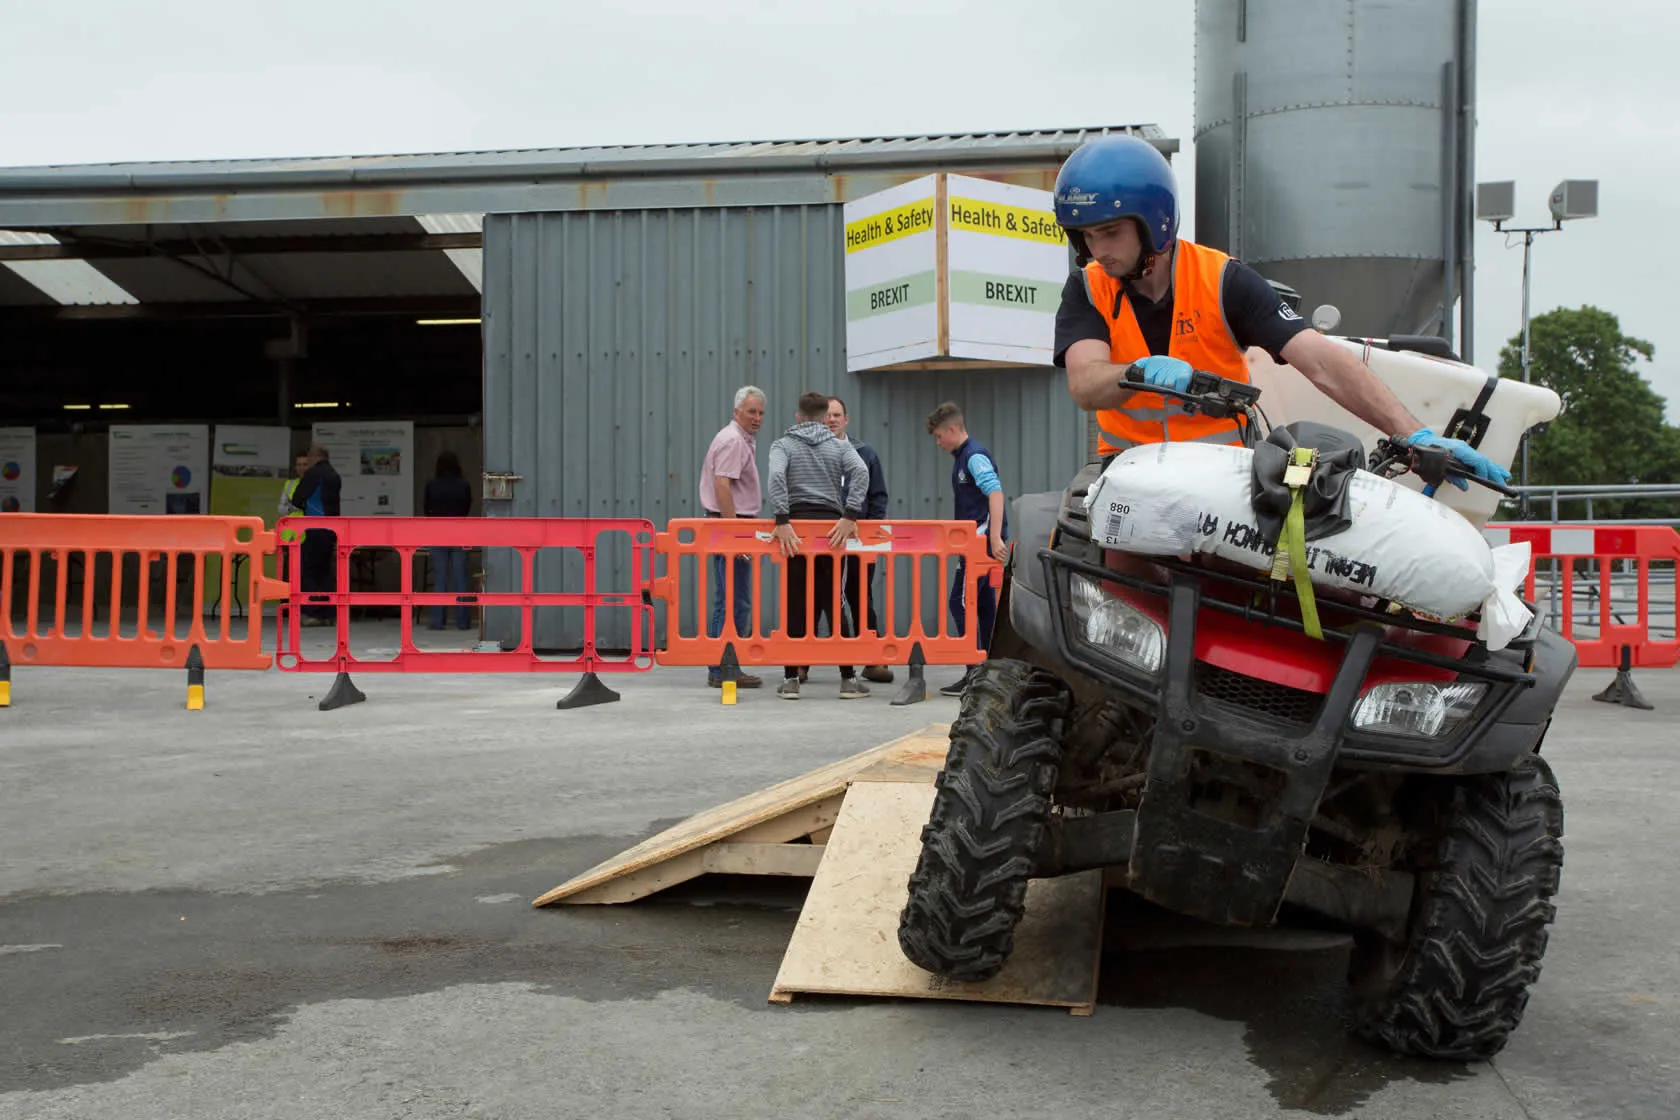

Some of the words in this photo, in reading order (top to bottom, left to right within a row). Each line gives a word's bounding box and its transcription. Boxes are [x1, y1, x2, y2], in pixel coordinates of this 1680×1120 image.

[847, 221, 881, 247] Health
[885, 216, 894, 235] &
[897, 207, 934, 232] Safety
[951, 203, 1001, 229] Health
[1006, 212, 1017, 231] &
[1022, 216, 1067, 243] Safety
[871, 283, 910, 310] BREXIT
[985, 281, 1037, 305] BREXIT
[1110, 502, 1130, 515] 088
